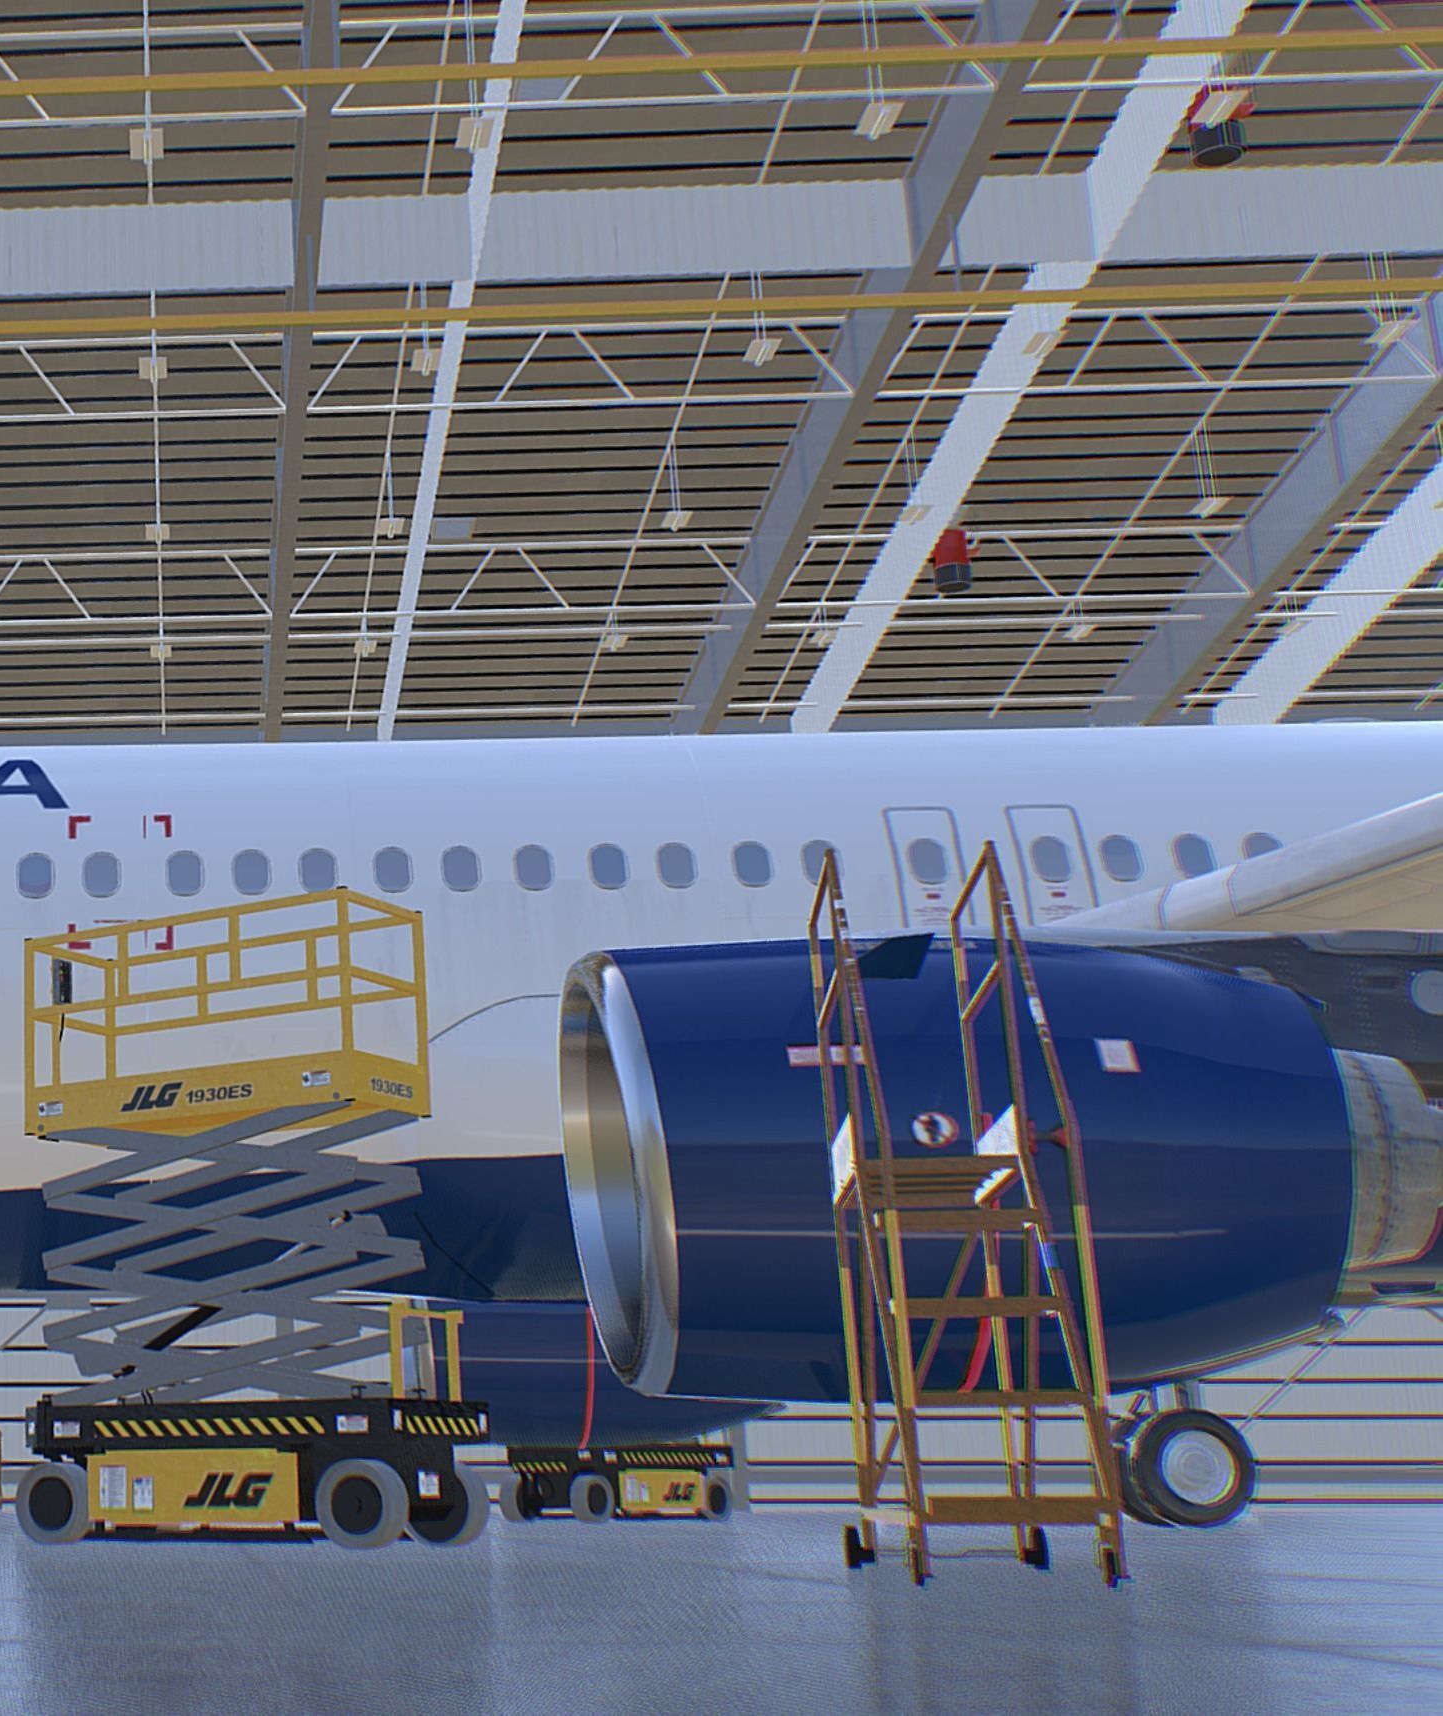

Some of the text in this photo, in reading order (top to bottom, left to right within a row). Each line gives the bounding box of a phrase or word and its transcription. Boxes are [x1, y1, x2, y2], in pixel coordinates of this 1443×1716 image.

[120, 1081, 253, 1112] JLG 1930ES
[370, 1077, 413, 1099] 1930ES
[183, 1472, 274, 1508] JLG
[662, 1481, 696, 1501] JLG
